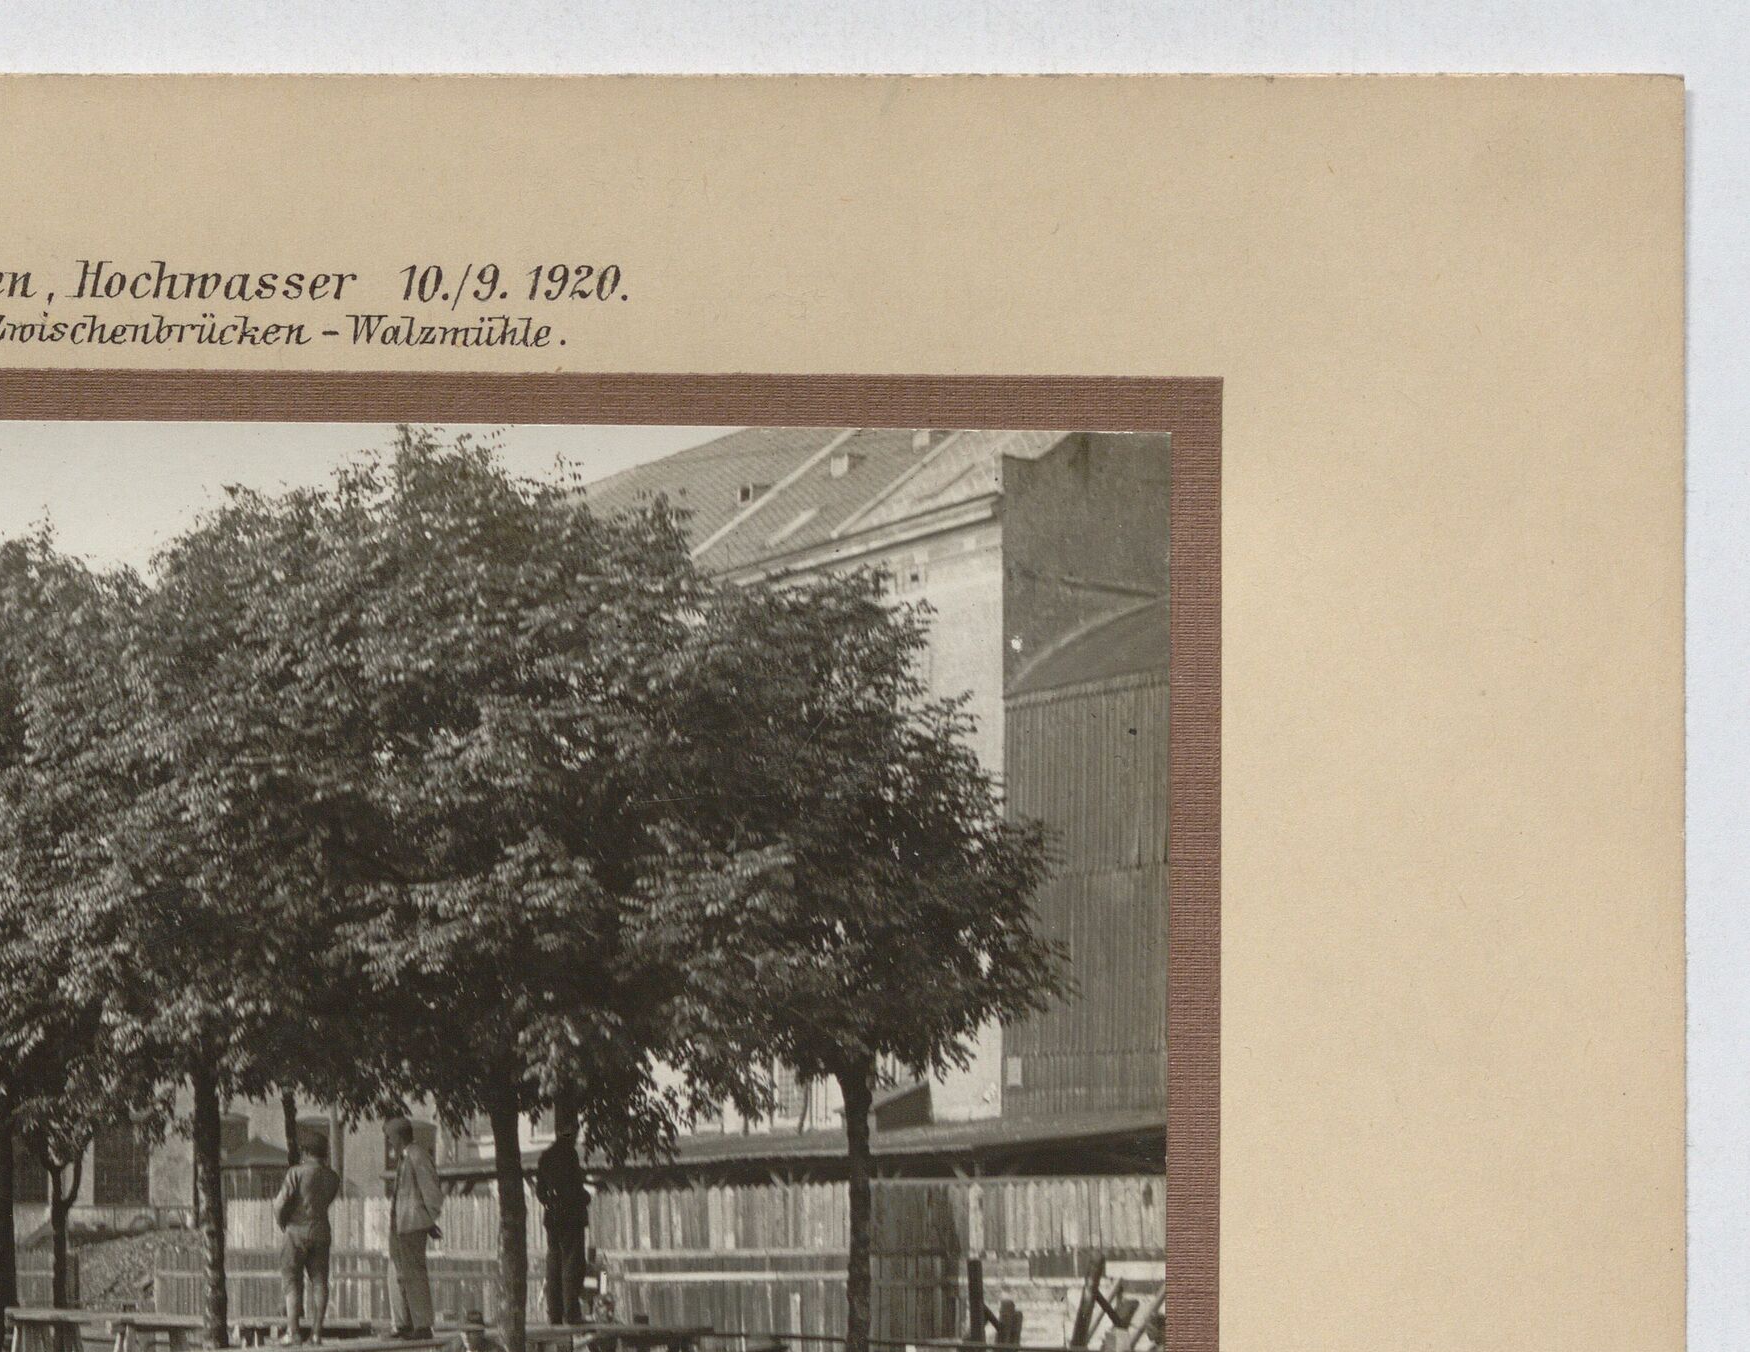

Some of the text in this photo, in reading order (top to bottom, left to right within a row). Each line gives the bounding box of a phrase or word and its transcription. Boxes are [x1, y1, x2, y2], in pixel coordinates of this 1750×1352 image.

[65, 259, 358, 302] Hochwasser
[399, 263, 508, 312] 10./9.
[528, 263, 628, 302] 1920.
